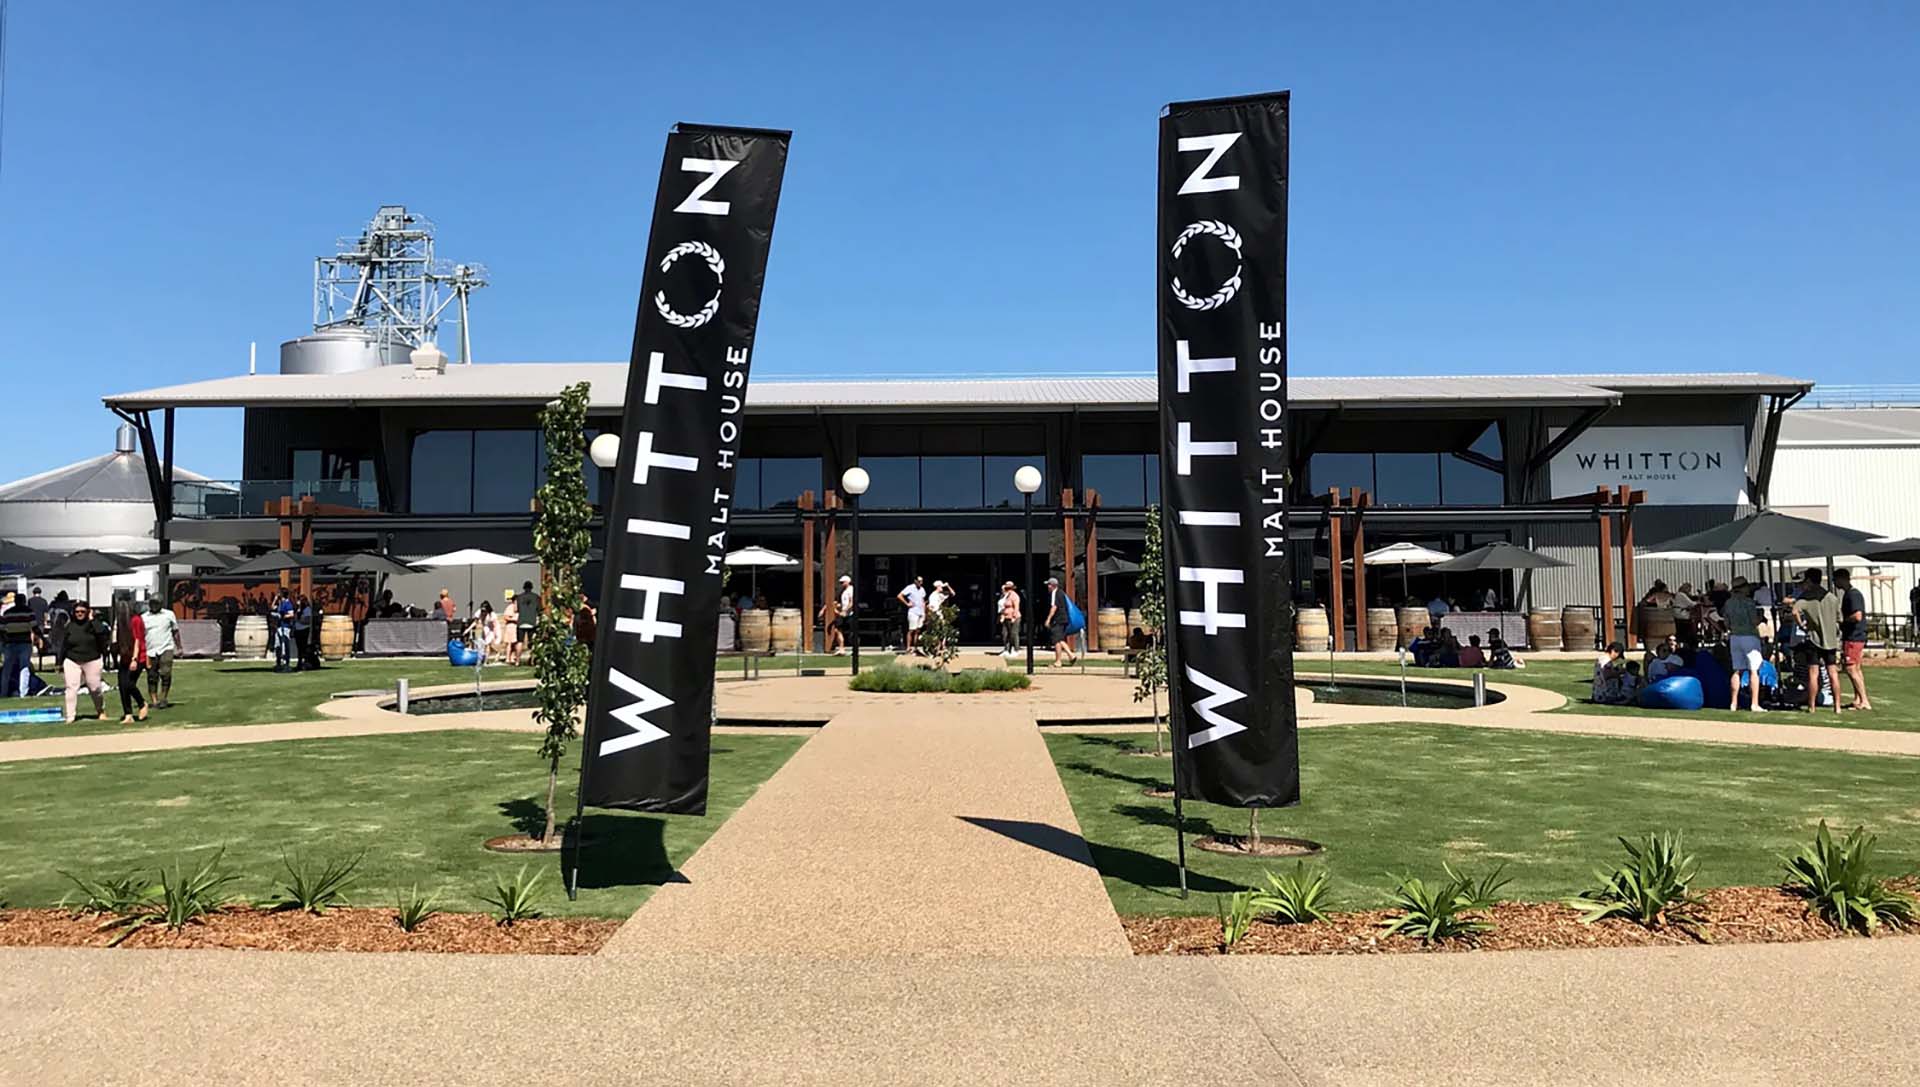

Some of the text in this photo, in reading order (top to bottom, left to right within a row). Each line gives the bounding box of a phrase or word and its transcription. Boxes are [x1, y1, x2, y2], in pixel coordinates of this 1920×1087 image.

[599, 157, 740, 757] WHITTON
[704, 346, 748, 575] MALT HOUSE
[1171, 132, 1248, 749] WHITTON
[1259, 322, 1284, 556] MALT HOUSE
[1576, 452, 1721, 470] WHITTON
